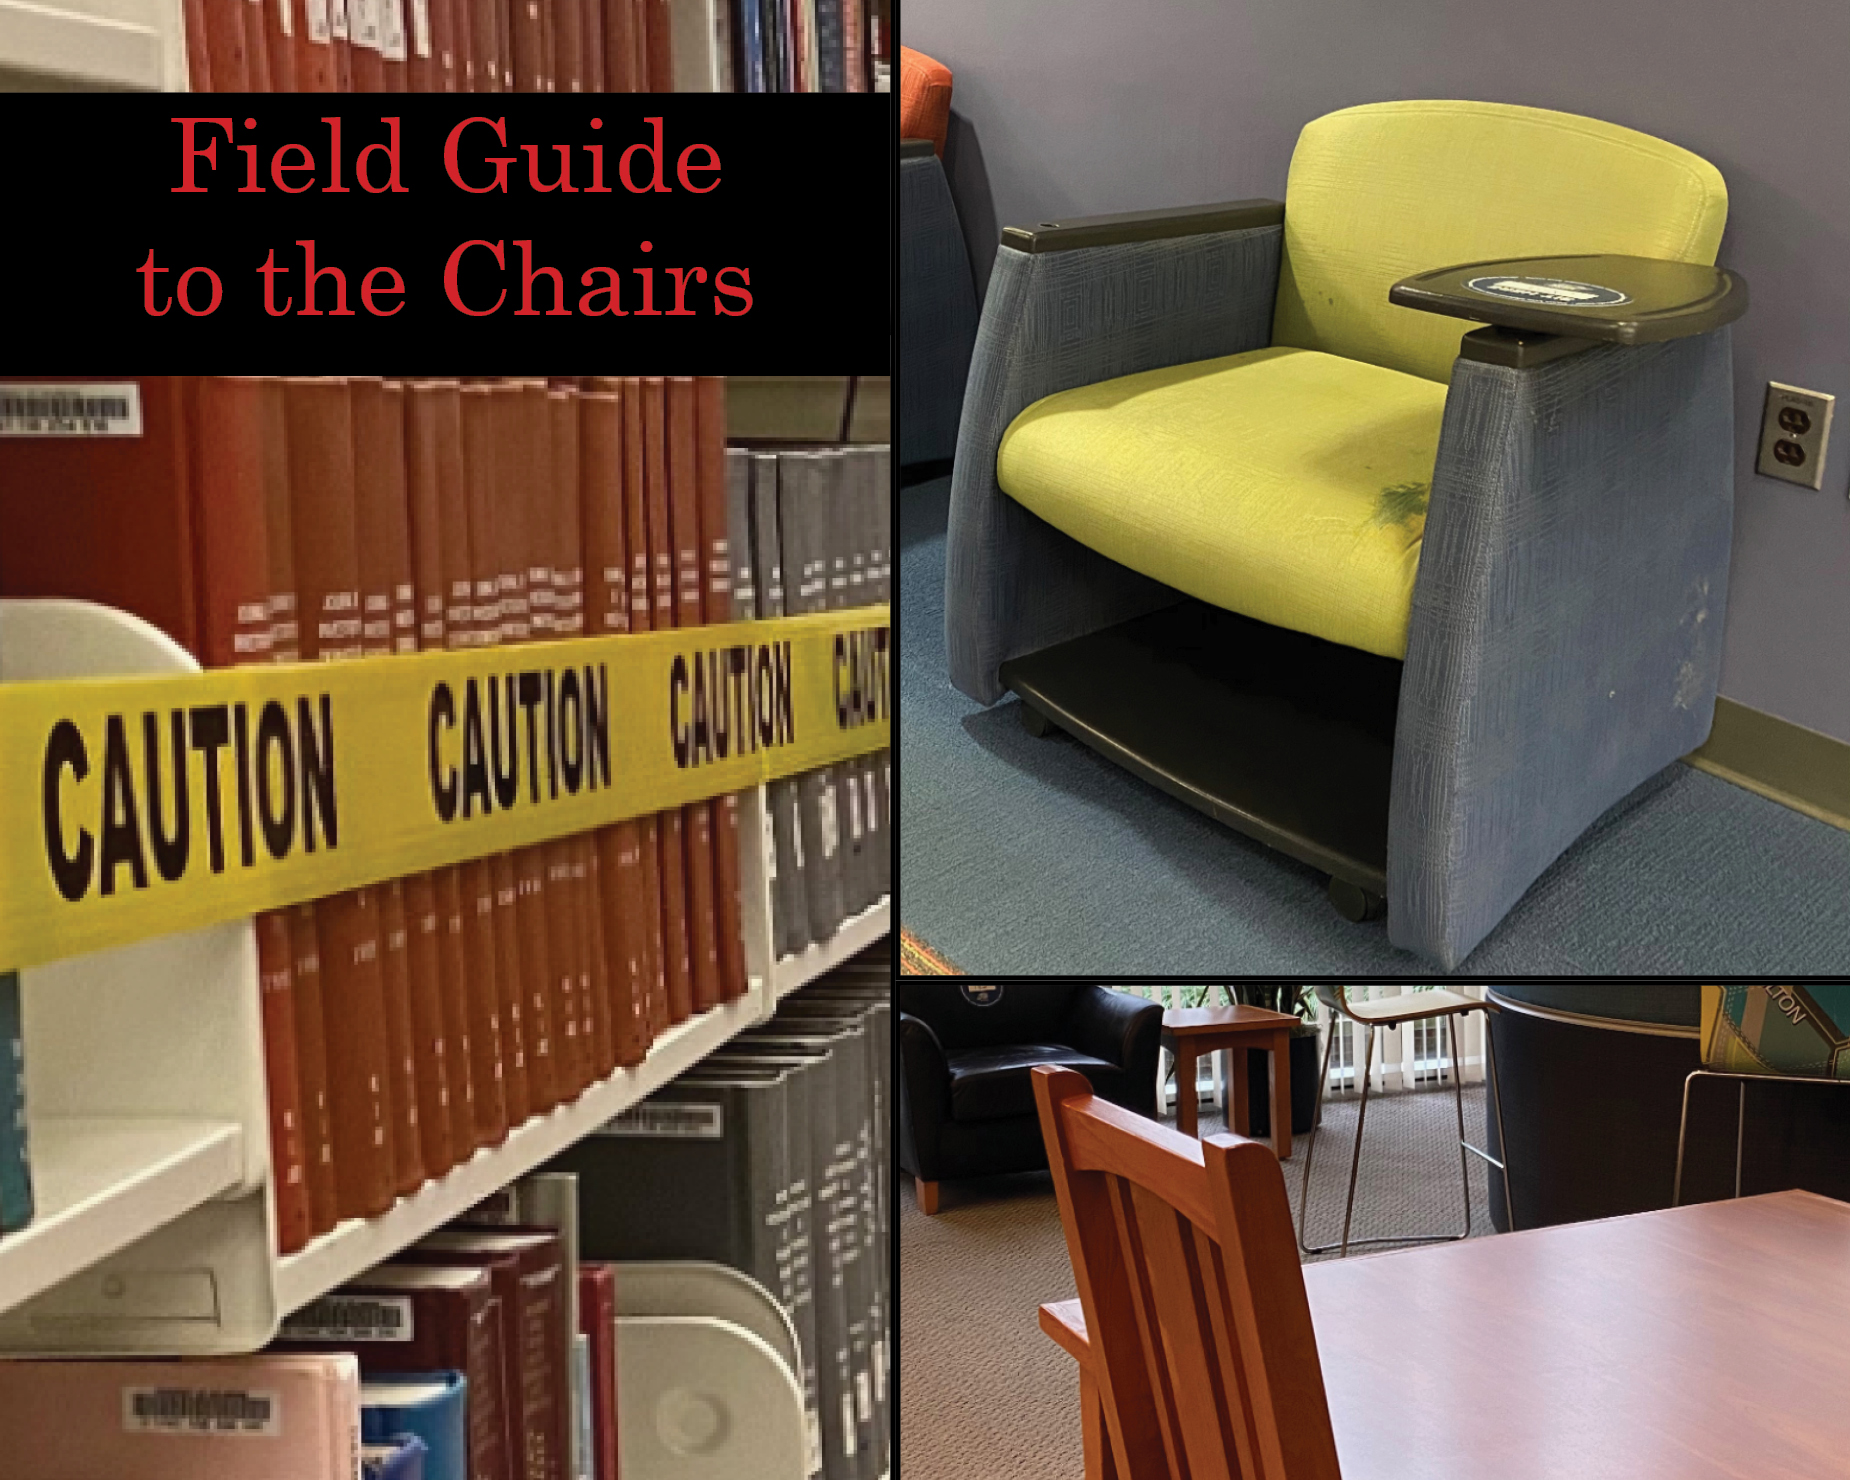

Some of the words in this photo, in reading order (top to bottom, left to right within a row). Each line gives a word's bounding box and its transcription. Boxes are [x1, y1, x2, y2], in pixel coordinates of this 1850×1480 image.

[43, 693, 338, 902] CAUTION
[428, 664, 612, 824] CAUTION
[670, 640, 794, 768] CAUTION
